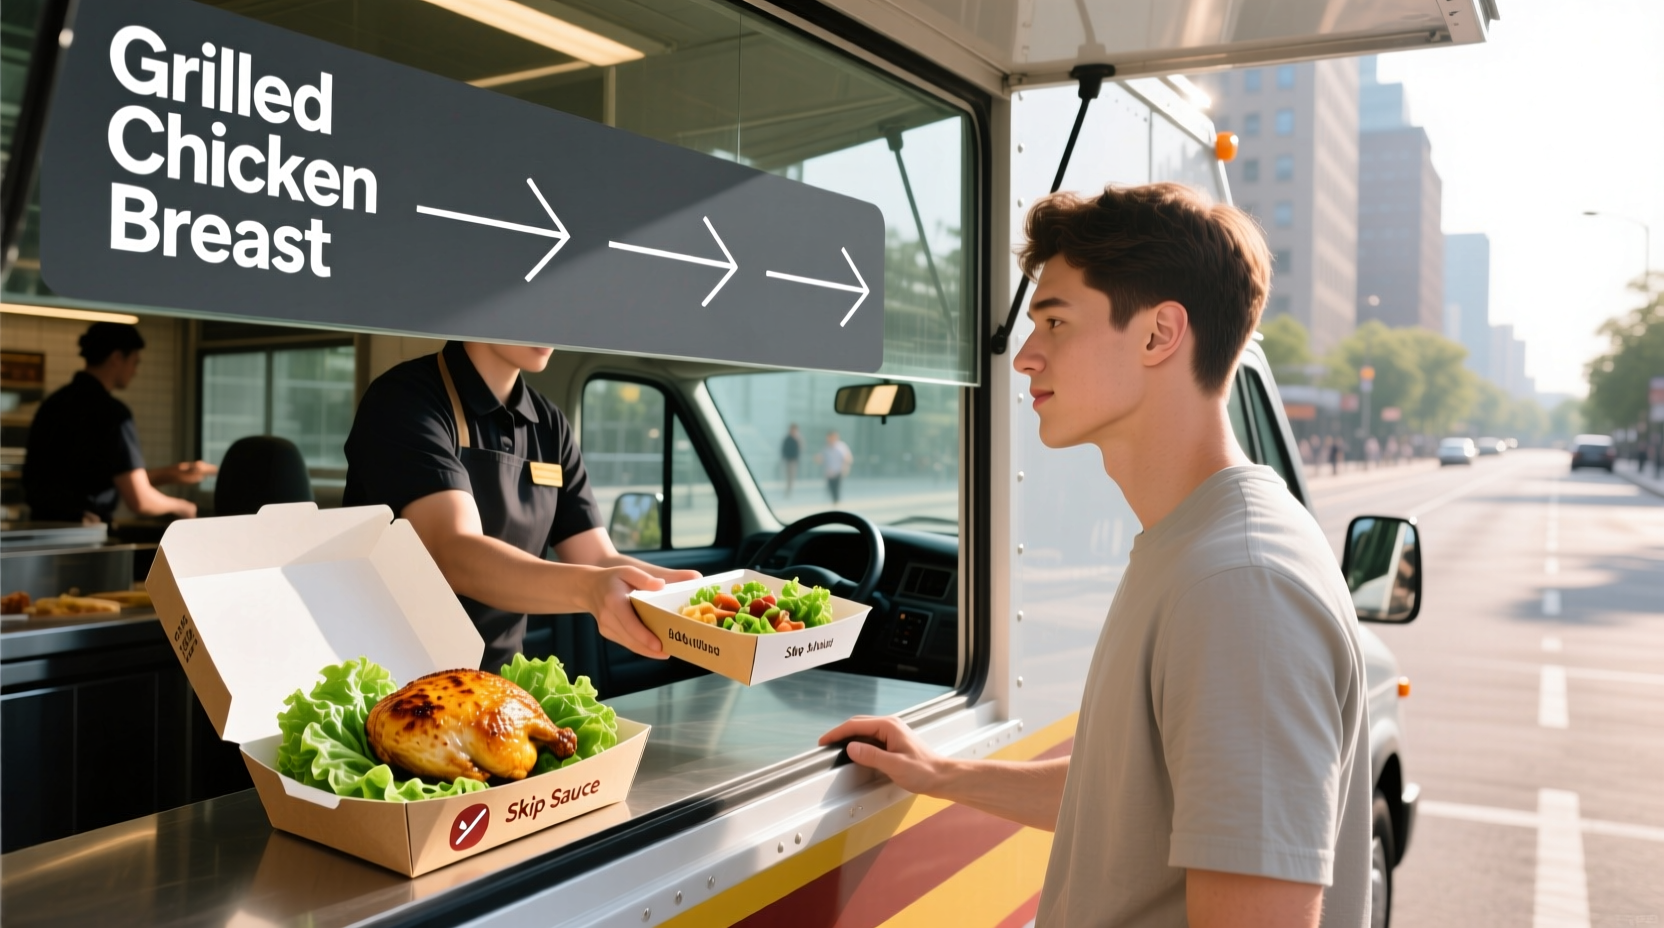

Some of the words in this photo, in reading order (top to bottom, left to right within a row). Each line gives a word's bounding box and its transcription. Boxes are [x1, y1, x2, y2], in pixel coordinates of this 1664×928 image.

[109, 25, 333, 135] Grilled
[107, 104, 378, 214] Chicken
[110, 182, 332, 278] Breast
[505, 795, 546, 822] Skip
[550, 780, 600, 808] Sauce
